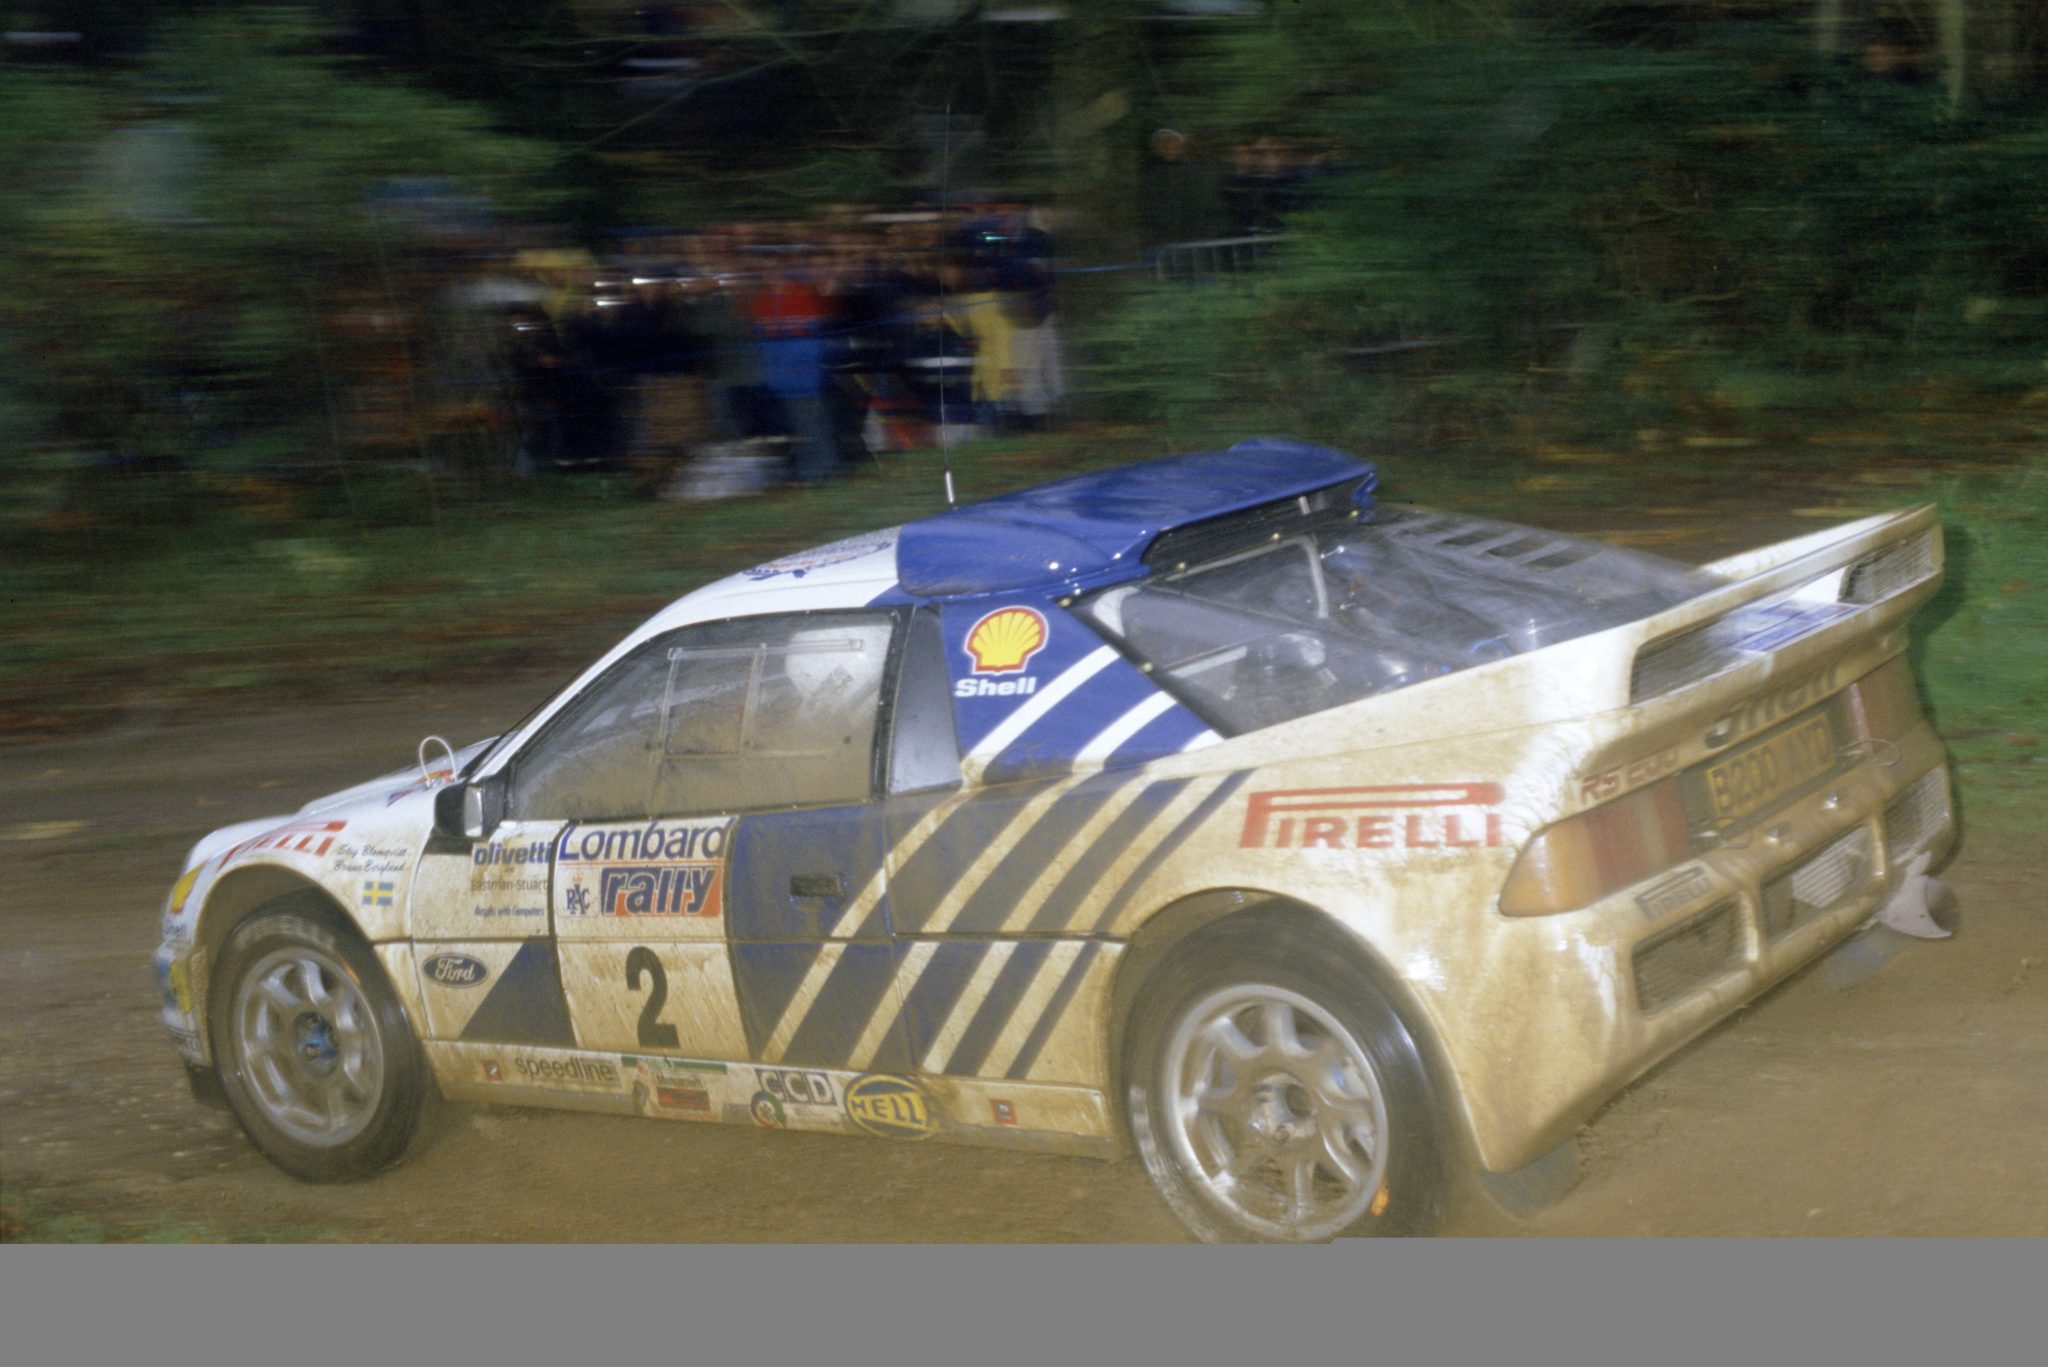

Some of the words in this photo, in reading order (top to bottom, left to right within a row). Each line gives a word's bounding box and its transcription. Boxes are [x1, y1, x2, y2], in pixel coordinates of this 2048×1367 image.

[954, 677, 1036, 697] Shell
[1238, 782, 1506, 849] PIRELLI
[473, 841, 552, 866] olivetti
[558, 816, 738, 861] Lombard
[603, 867, 719, 915] rally
[434, 958, 476, 981] Ford
[624, 946, 680, 1050] 2
[514, 1056, 614, 1082] speedline
[759, 1070, 835, 1104] CCD
